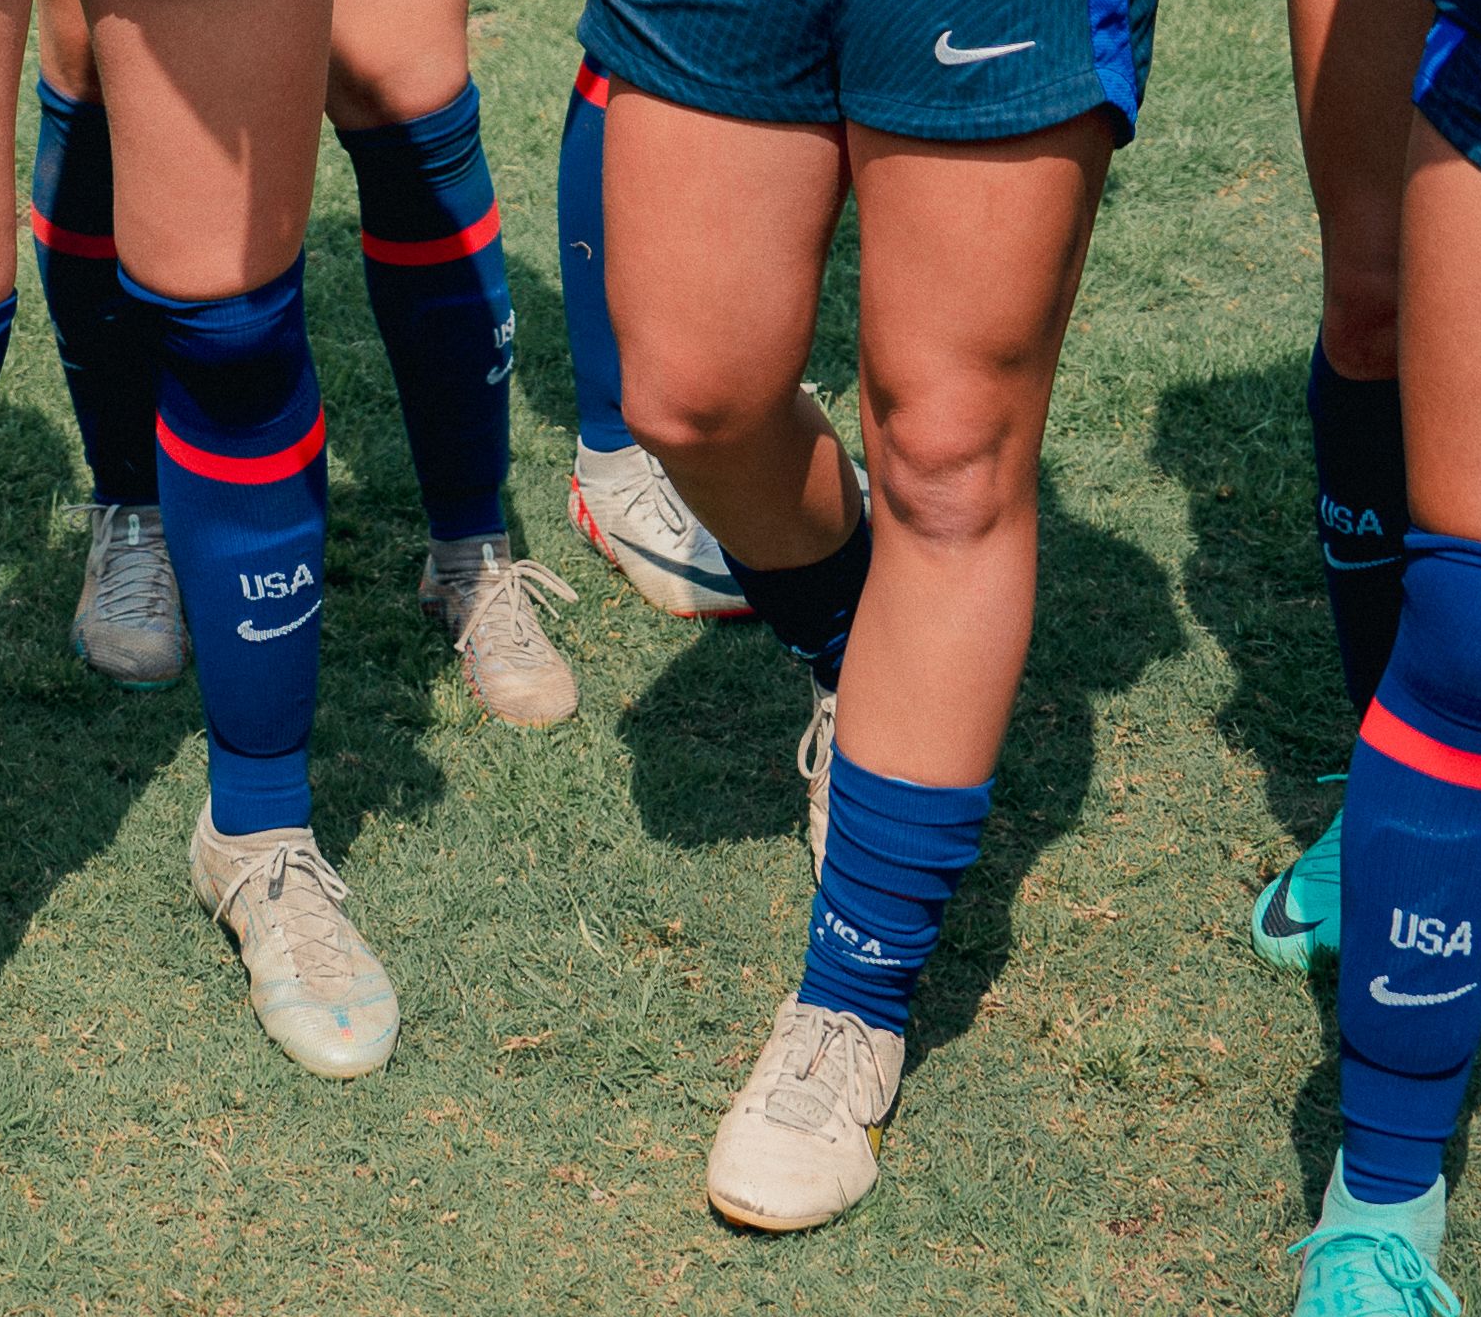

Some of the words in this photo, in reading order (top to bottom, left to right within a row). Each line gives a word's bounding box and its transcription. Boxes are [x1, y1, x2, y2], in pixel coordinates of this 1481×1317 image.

[1321, 494, 1384, 536] USA
[239, 564, 315, 601] USA
[1389, 907, 1473, 957] USA
